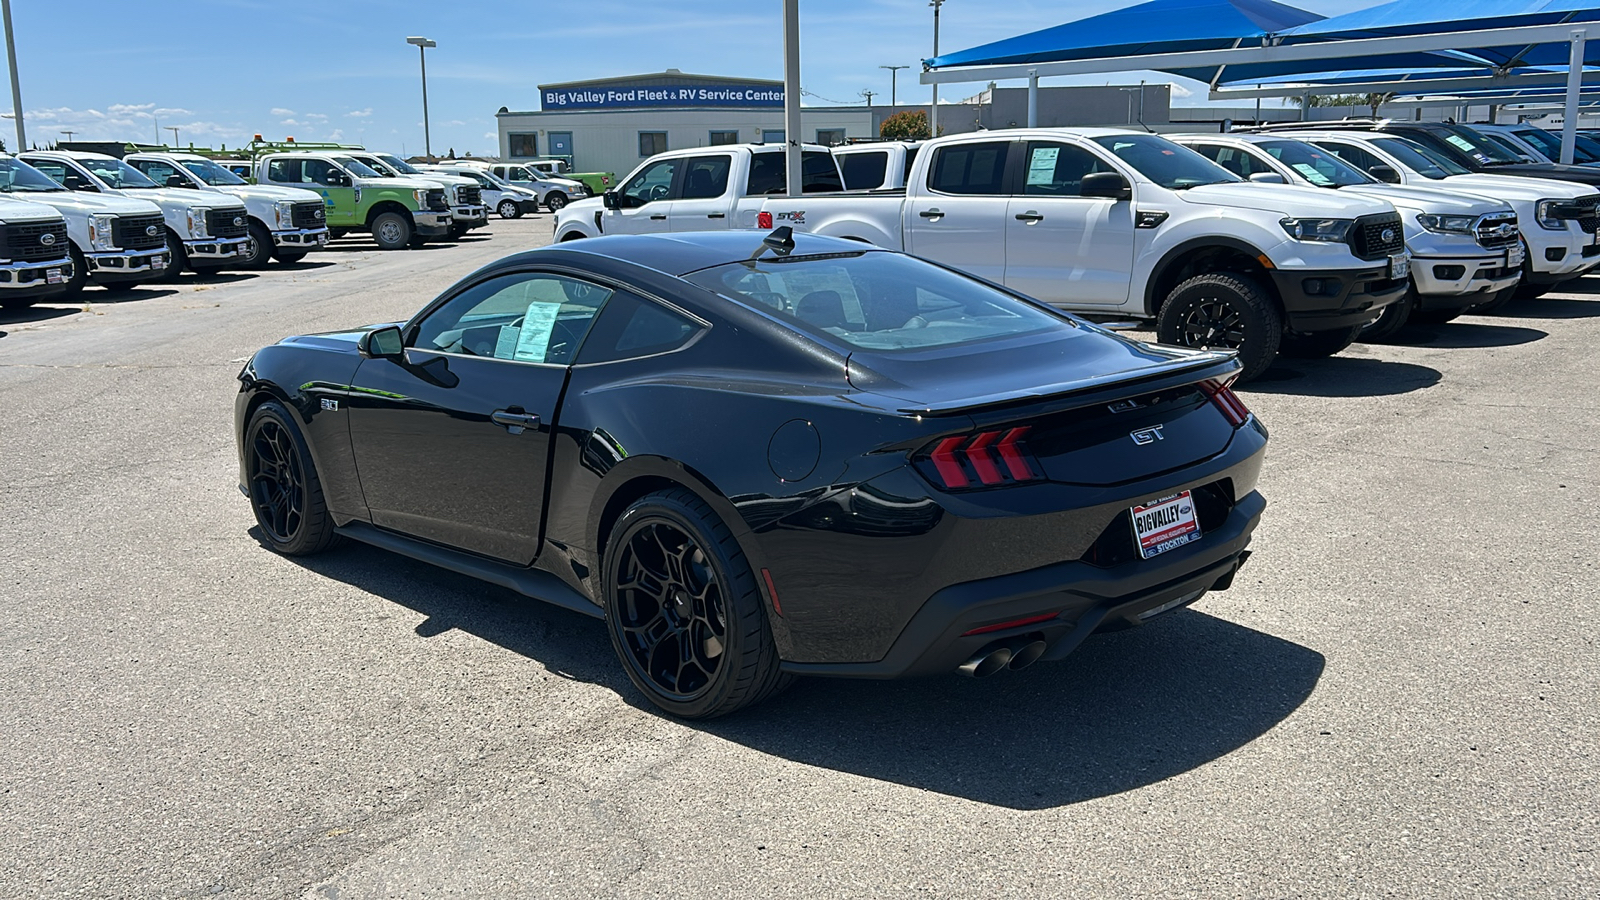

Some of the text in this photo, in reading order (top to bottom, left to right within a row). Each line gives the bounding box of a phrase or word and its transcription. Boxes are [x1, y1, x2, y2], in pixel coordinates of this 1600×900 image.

[546, 89, 785, 105] Big Valley Ford Fleet & RV Service Center
[776, 211, 806, 221] STX
[1129, 423, 1165, 446] GT
[1136, 503, 1180, 534] BIGVALLEY
[1156, 534, 1190, 553] STOCKTON
